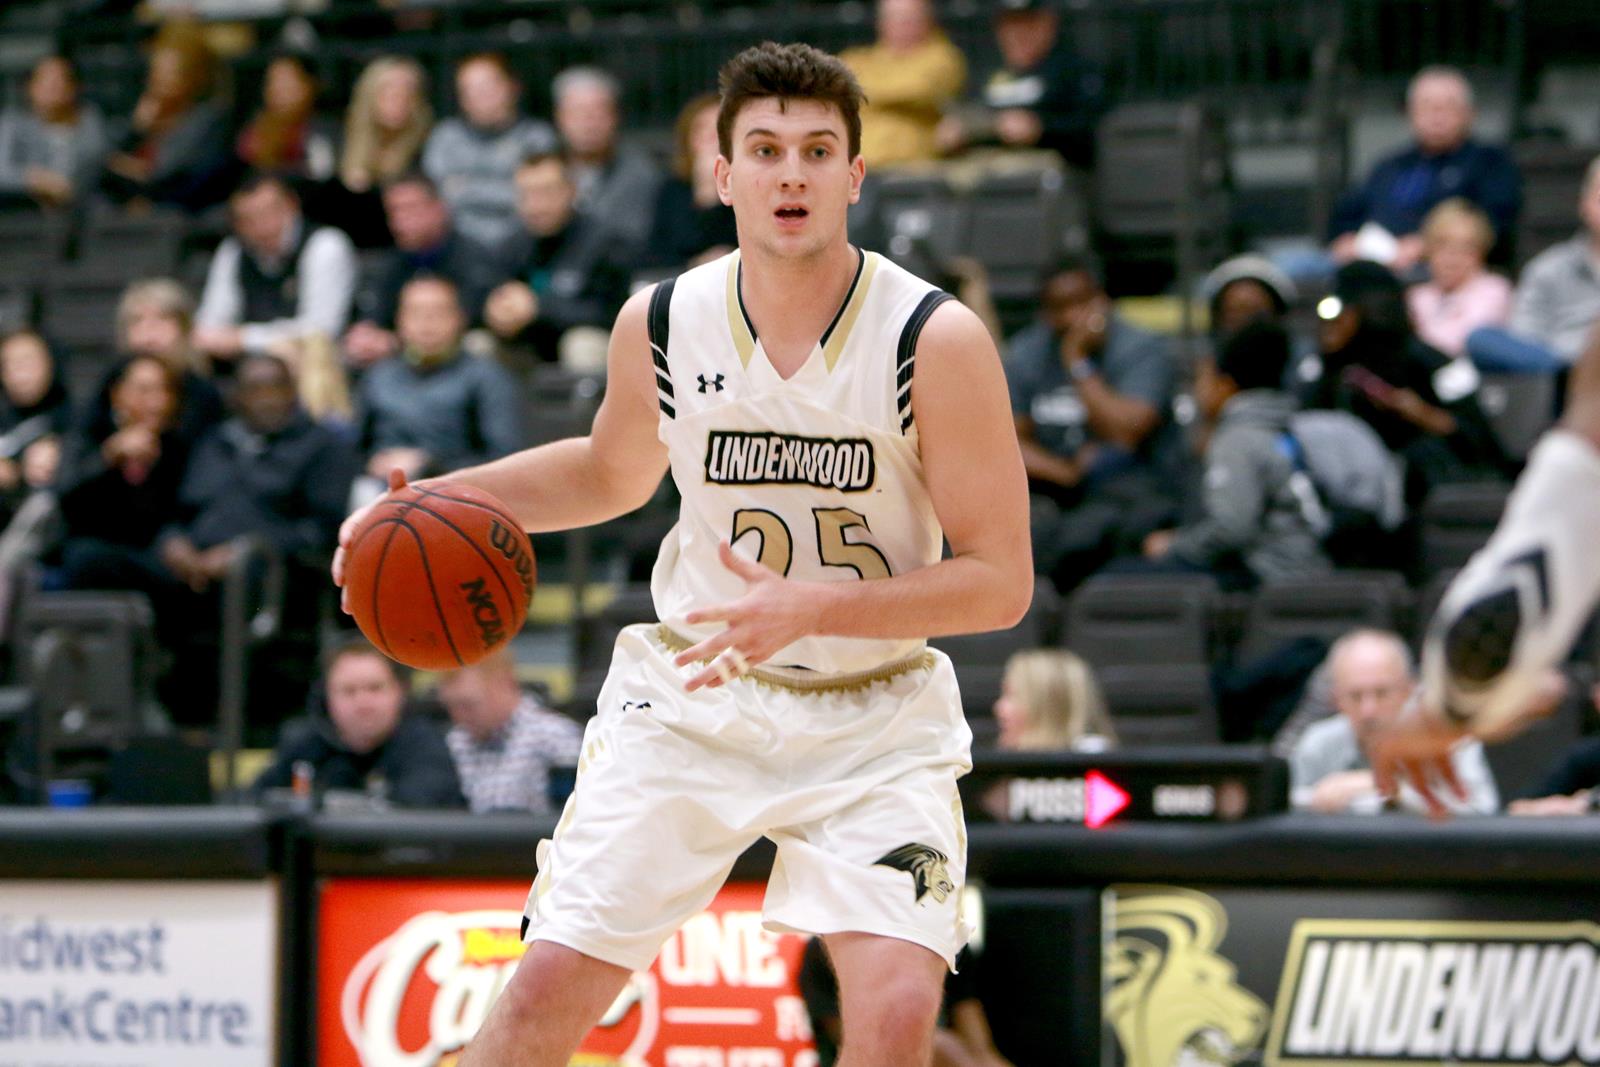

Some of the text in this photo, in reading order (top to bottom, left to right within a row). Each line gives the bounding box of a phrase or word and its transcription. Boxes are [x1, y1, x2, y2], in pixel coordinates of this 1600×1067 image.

[706, 433, 872, 490] LINDENWOOD
[730, 508, 892, 579] 25
[661, 911, 788, 988] ONE
